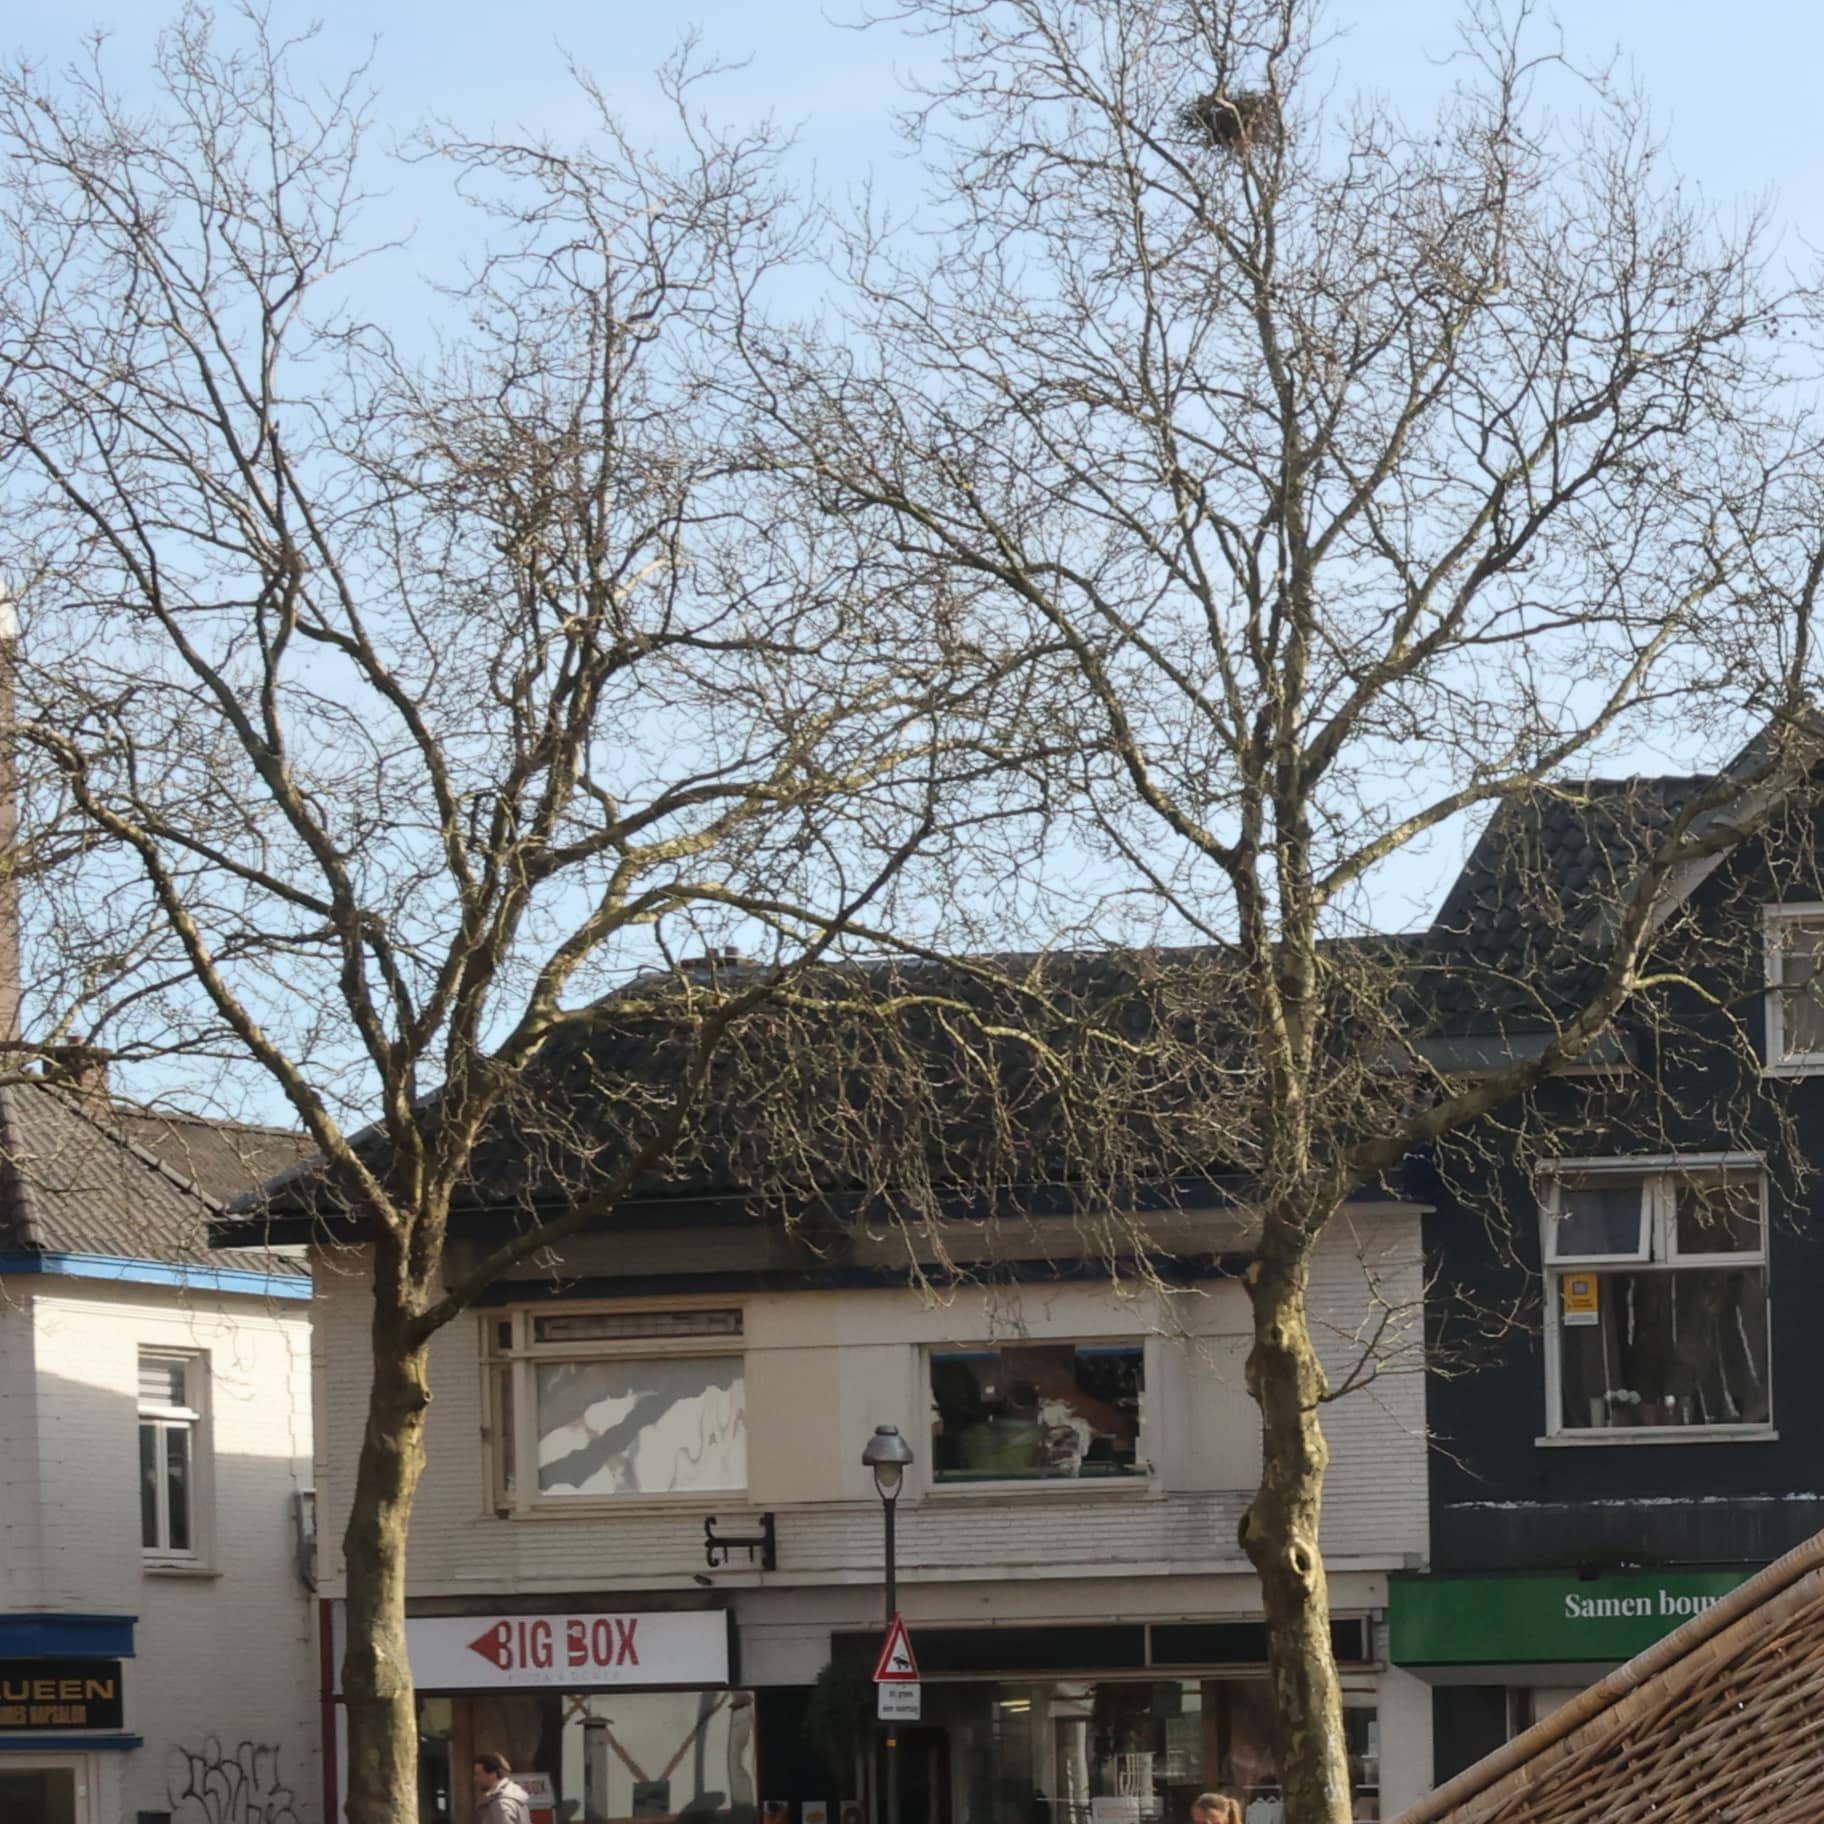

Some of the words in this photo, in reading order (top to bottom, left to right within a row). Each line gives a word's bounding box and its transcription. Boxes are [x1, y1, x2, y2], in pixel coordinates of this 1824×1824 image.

[1565, 1593, 1652, 1618] Samen
[467, 1619, 553, 1671] BIG
[567, 1618, 640, 1667] BOX
[0, 1679, 114, 1700] UEEN
